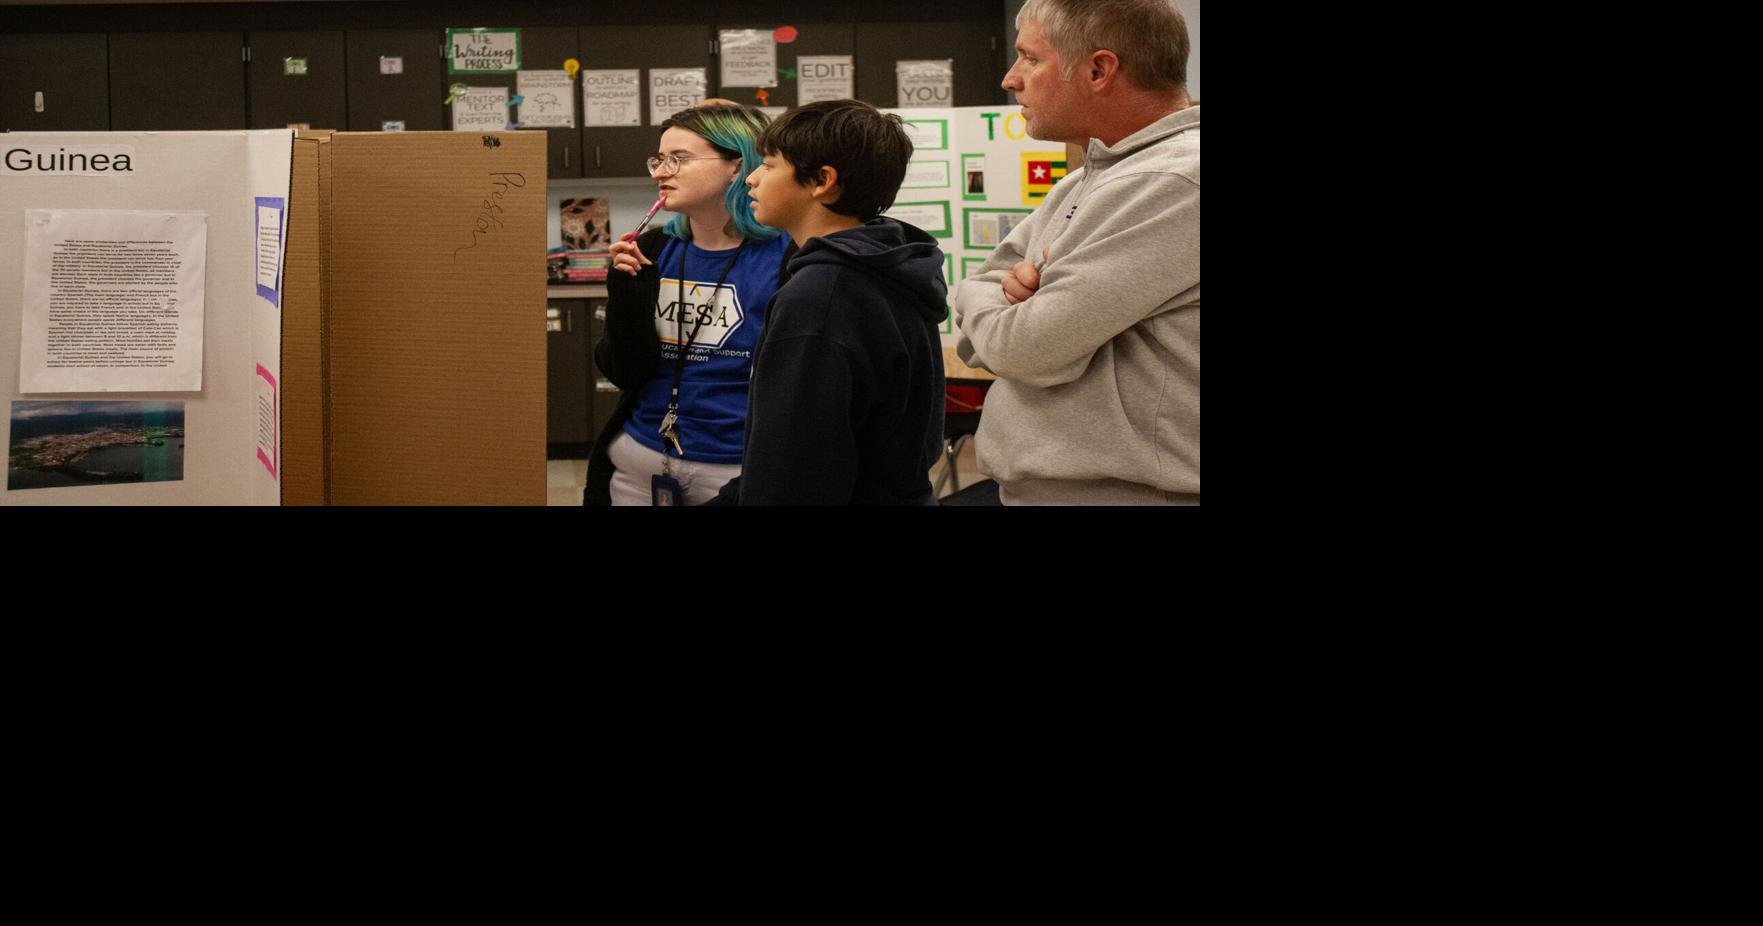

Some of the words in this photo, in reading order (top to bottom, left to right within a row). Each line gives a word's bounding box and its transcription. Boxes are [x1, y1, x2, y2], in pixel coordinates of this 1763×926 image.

[454, 44, 514, 64] Writing
[465, 58, 503, 70] PROCESS
[802, 63, 850, 78] EDIT
[586, 76, 636, 86] OUTLINE
[456, 95, 504, 104] MENTOR
[586, 91, 638, 99] ROADMAP
[655, 94, 702, 107] BEST
[902, 86, 950, 102] YOU
[458, 116, 504, 124] EXPERTS
[4, 148, 134, 171] Guinea
[655, 302, 728, 328] MESA
